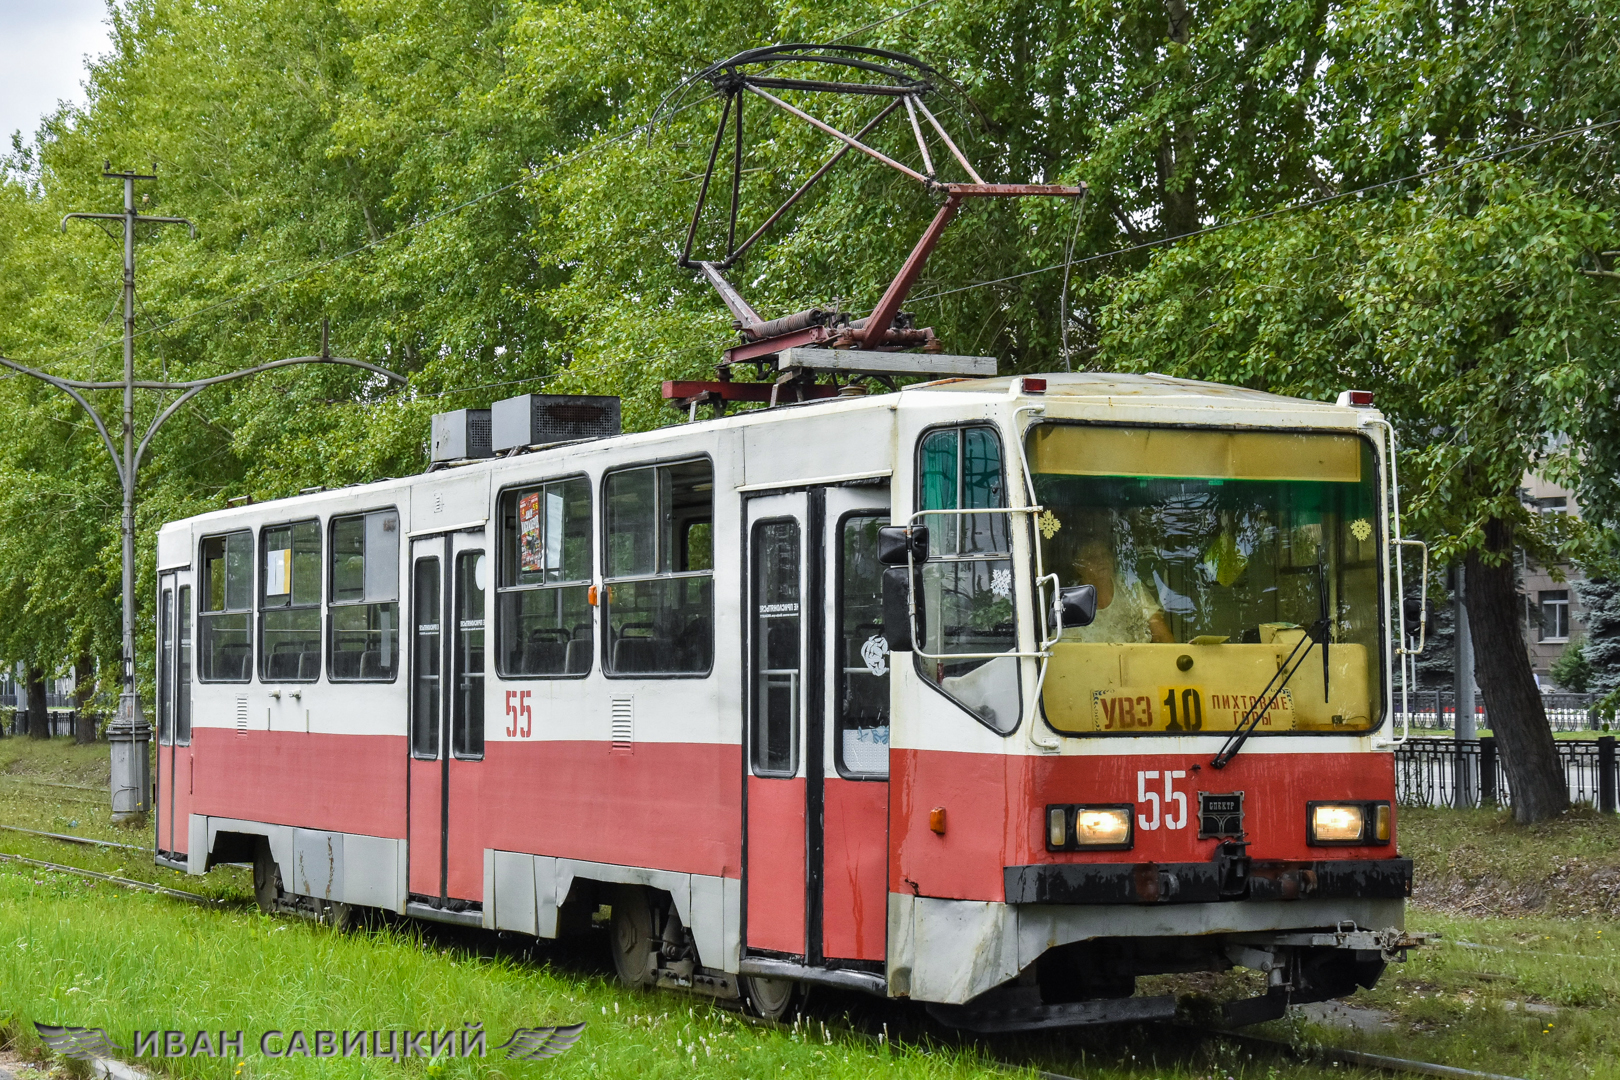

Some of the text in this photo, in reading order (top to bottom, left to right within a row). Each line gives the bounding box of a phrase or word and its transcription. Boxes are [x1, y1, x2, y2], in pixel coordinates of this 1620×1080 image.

[506, 690, 532, 738] 55
[1100, 696, 1153, 730] УВЗ
[1164, 688, 1203, 731] 10
[1212, 694, 1289, 711] ПИХТОВЫЕ
[1137, 770, 1188, 831] 55
[1209, 801, 1235, 811] СПЕКТР
